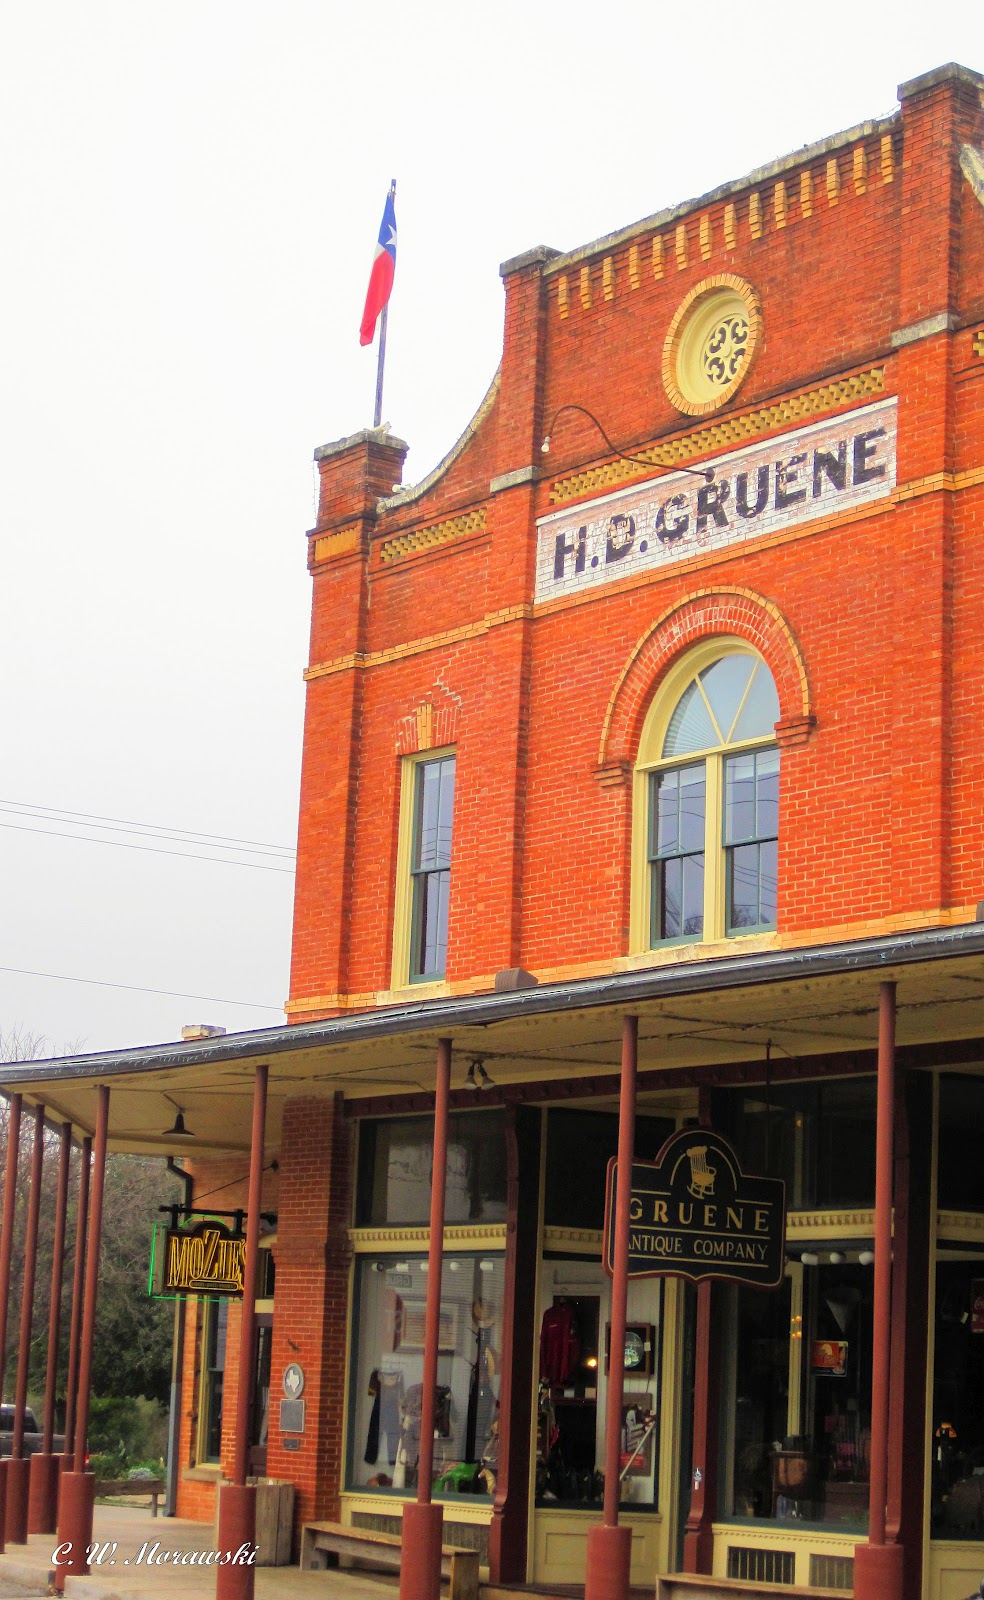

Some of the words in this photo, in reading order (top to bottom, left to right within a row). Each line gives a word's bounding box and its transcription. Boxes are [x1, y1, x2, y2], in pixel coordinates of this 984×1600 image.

[655, 427, 887, 546] GRUENE
[629, 1197, 770, 1232] GRUENE
[628, 1234, 683, 1256] NTIQUE
[693, 1239, 768, 1261] COMPANY
